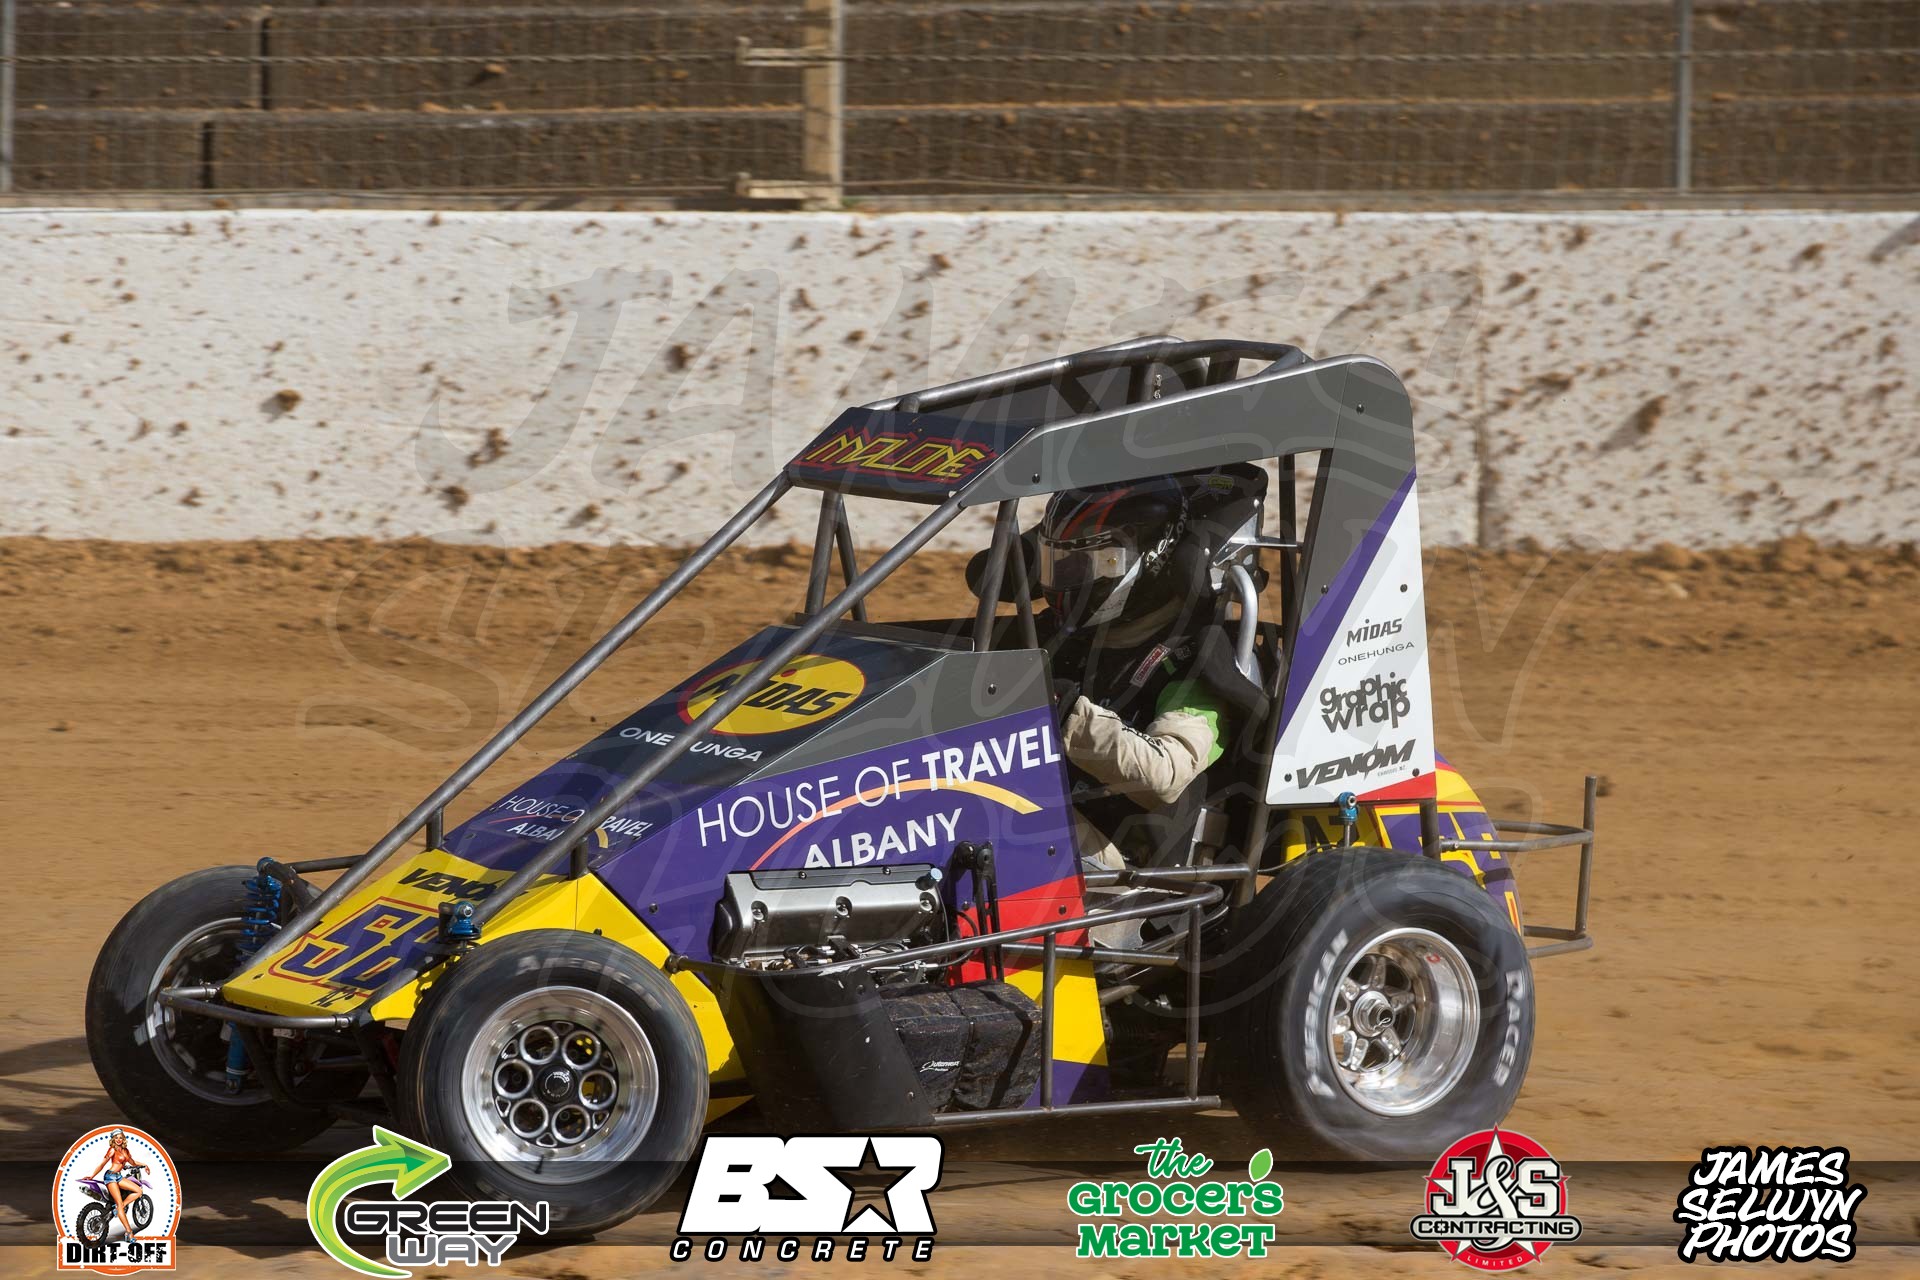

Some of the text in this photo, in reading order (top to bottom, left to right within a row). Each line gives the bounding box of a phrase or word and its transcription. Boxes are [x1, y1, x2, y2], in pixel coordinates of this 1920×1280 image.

[800, 430, 991, 480] MALONE
[1338, 641, 1414, 665] ONEHUNGA
[694, 668, 853, 716] MDAS
[1320, 672, 1408, 714] graphic
[1321, 694, 1410, 733] wrap
[619, 727, 763, 762] ONEUNGA
[1296, 739, 1416, 789] VENOM
[698, 776, 842, 847] HOUSE
[855, 759, 910, 808] OF
[922, 726, 1061, 792] TRAVEL
[500, 795, 568, 819] HOUSE
[600, 815, 653, 838] RAVEL
[804, 808, 962, 870] ALBANY
[397, 868, 503, 901] VENO
[1492, 968, 1525, 1087] RACER
